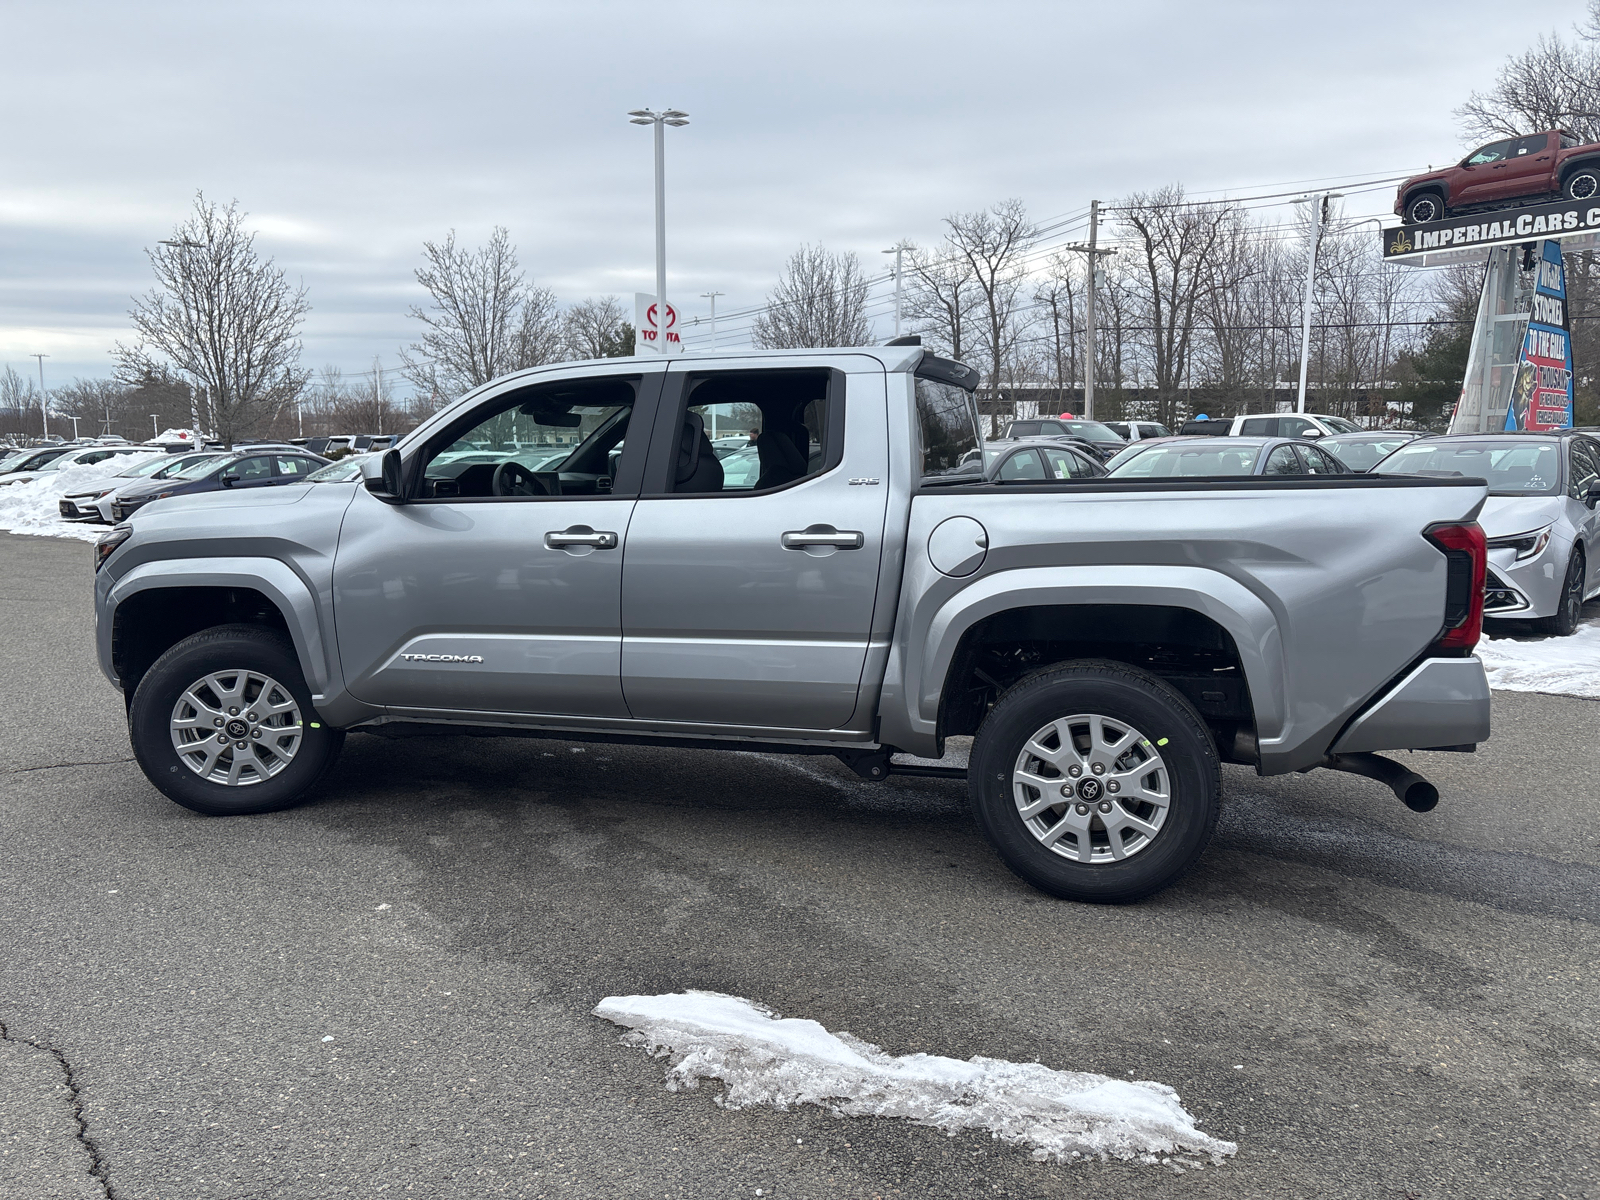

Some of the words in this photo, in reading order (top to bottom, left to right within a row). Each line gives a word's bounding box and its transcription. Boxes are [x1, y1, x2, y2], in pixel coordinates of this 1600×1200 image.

[641, 329, 680, 343] TOTA
[1529, 329, 1537, 356] TO
[1538, 330, 1550, 358] THE
[1550, 333, 1565, 360] GILLS
[400, 653, 484, 664] TACOMA
